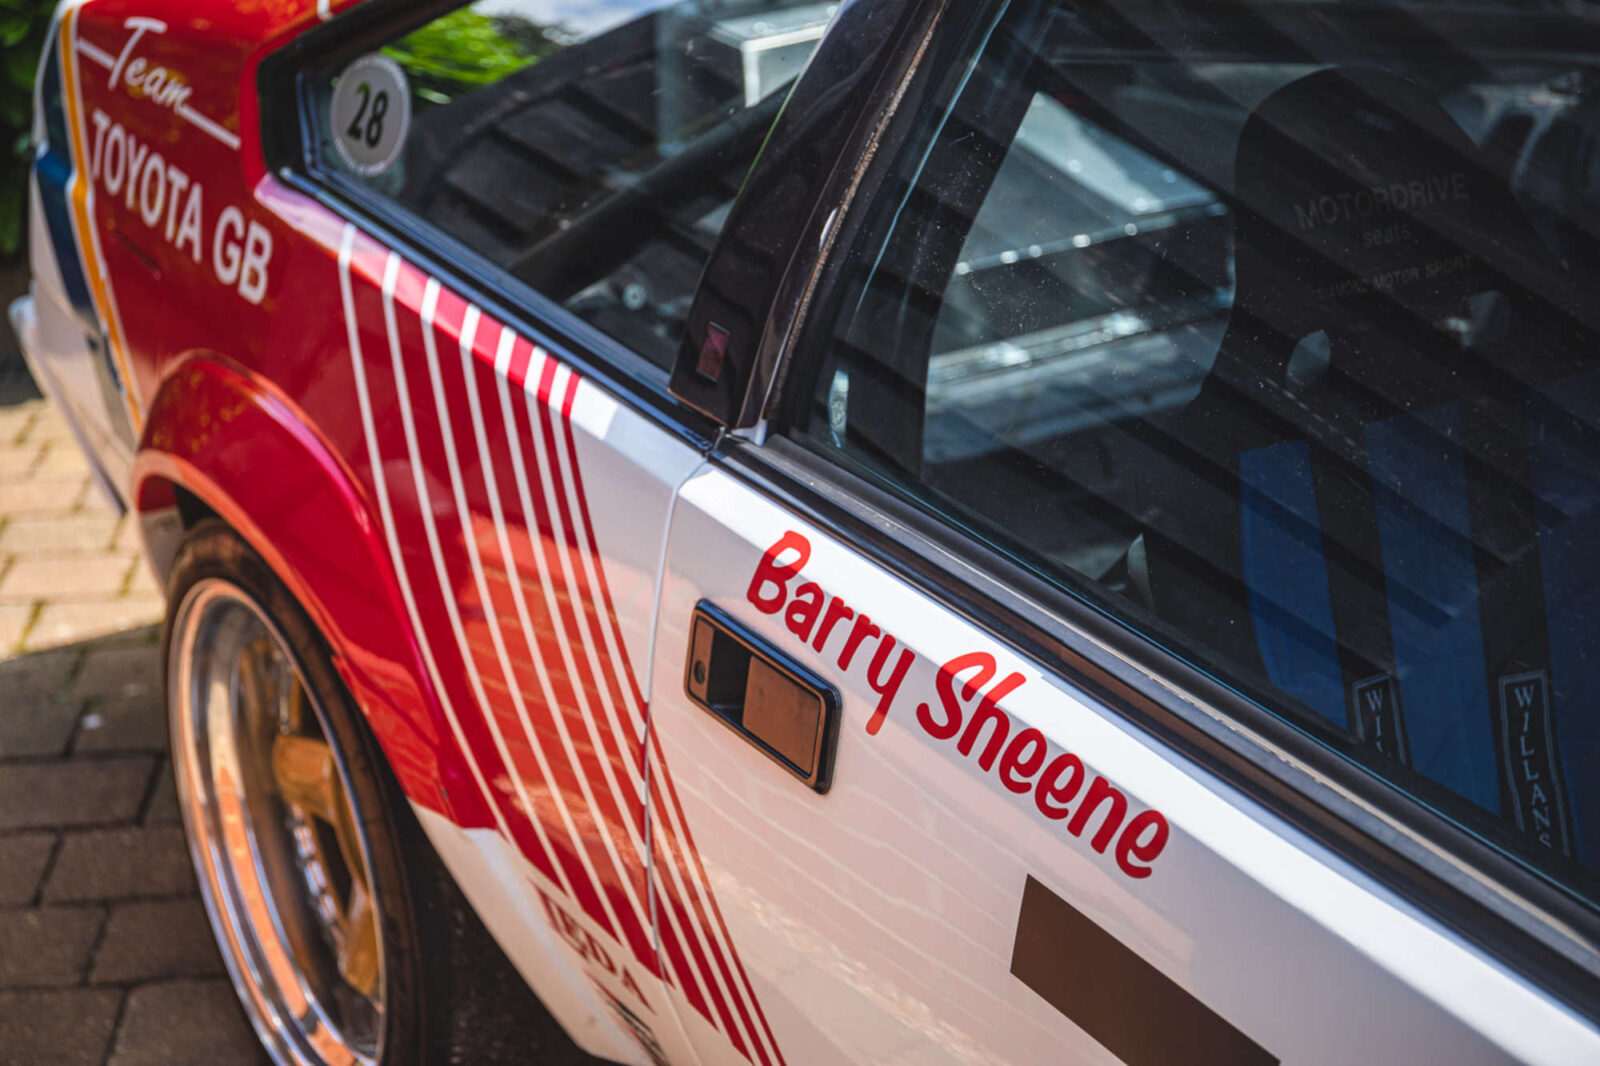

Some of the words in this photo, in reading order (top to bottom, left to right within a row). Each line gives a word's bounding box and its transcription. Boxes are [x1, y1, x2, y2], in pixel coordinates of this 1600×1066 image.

[108, 17, 193, 116] Team
[346, 82, 390, 149] 28
[91, 109, 204, 263] TOYOTA
[213, 206, 273, 304] GB
[1293, 172, 1470, 230] MOTORDRIVE
[1373, 267, 1421, 290] MOTOR
[746, 530, 916, 736] Barry
[915, 651, 1170, 880] Sheene
[1514, 685, 1553, 849] WILLANS
